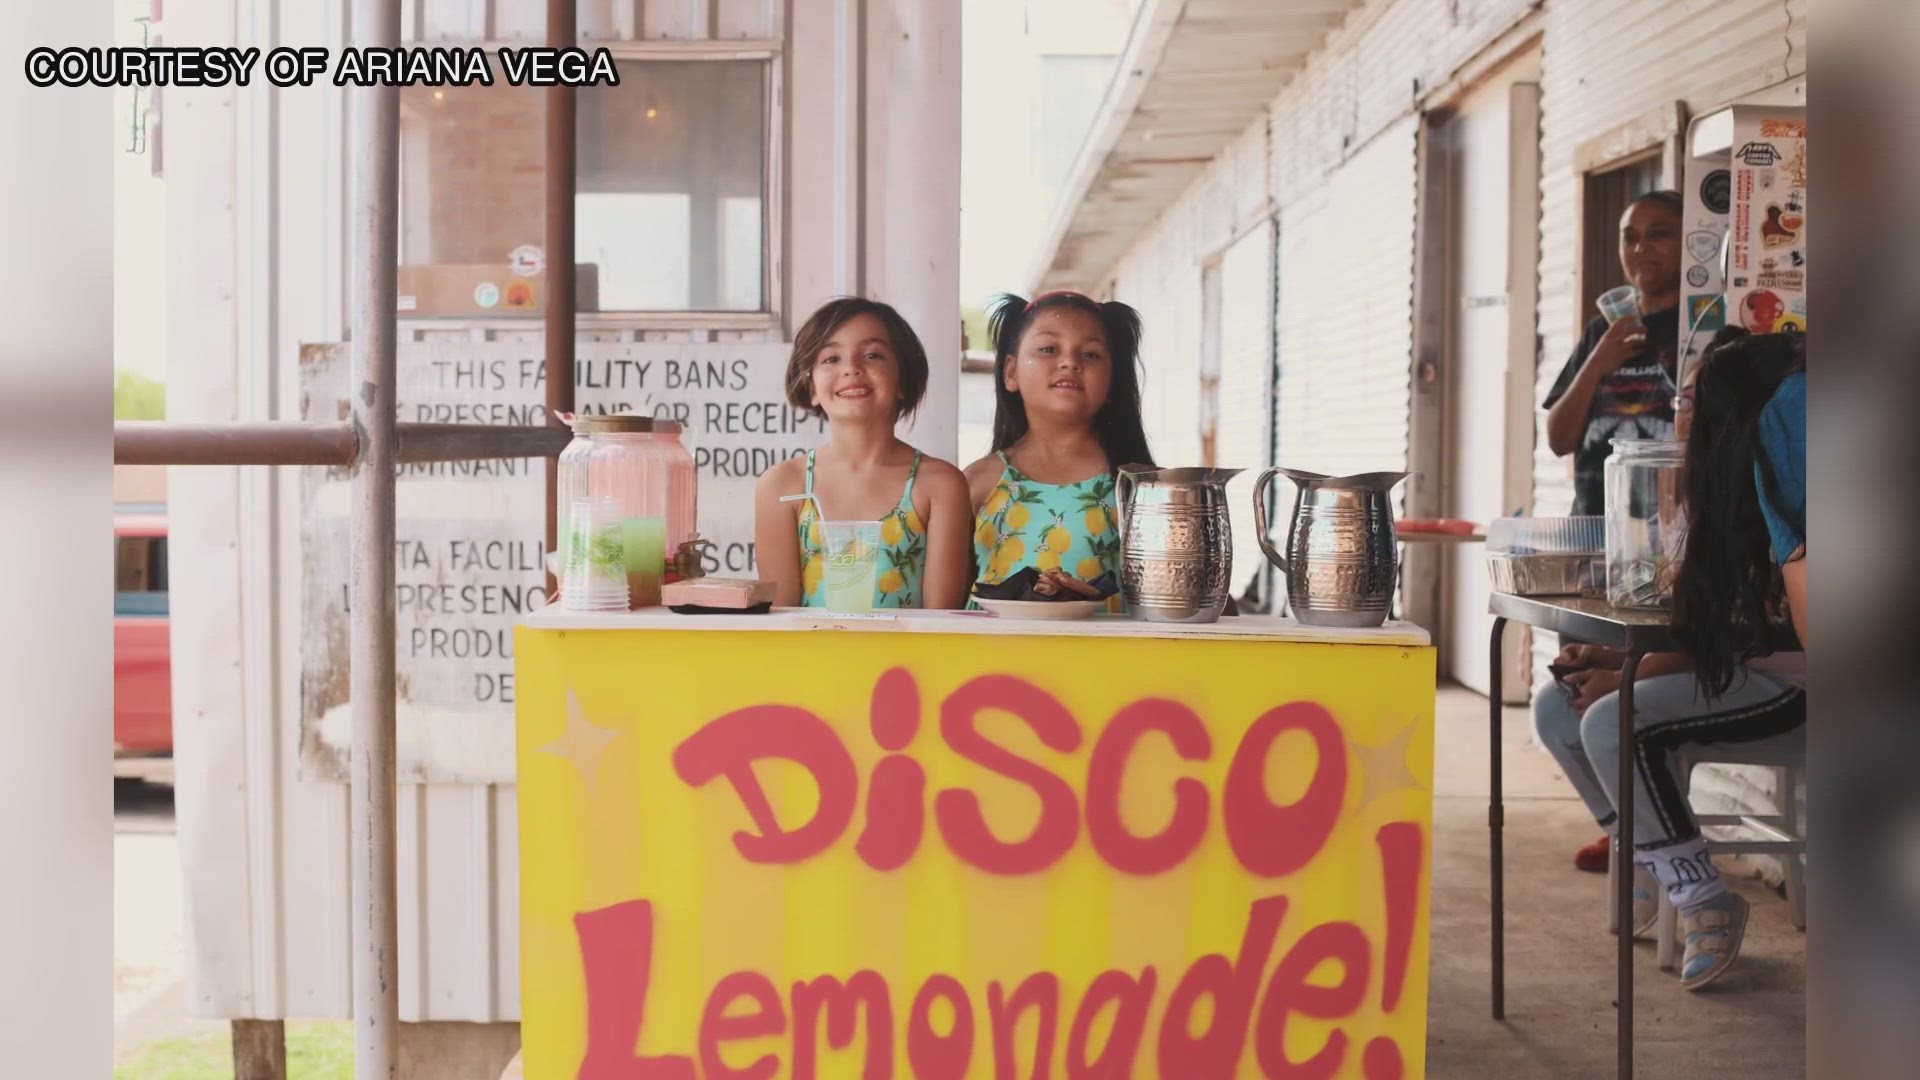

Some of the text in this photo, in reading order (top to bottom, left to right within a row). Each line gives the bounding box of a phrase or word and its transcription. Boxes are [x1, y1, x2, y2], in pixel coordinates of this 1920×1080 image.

[431, 359, 749, 390] THIS FAILITY BANS
[417, 403, 547, 427] PRESENC
[450, 541, 544, 571] FACILI
[396, 585, 547, 615] PRESENC
[411, 627, 515, 658] PRODU
[573, 822, 1423, 1080] Lemonade!
